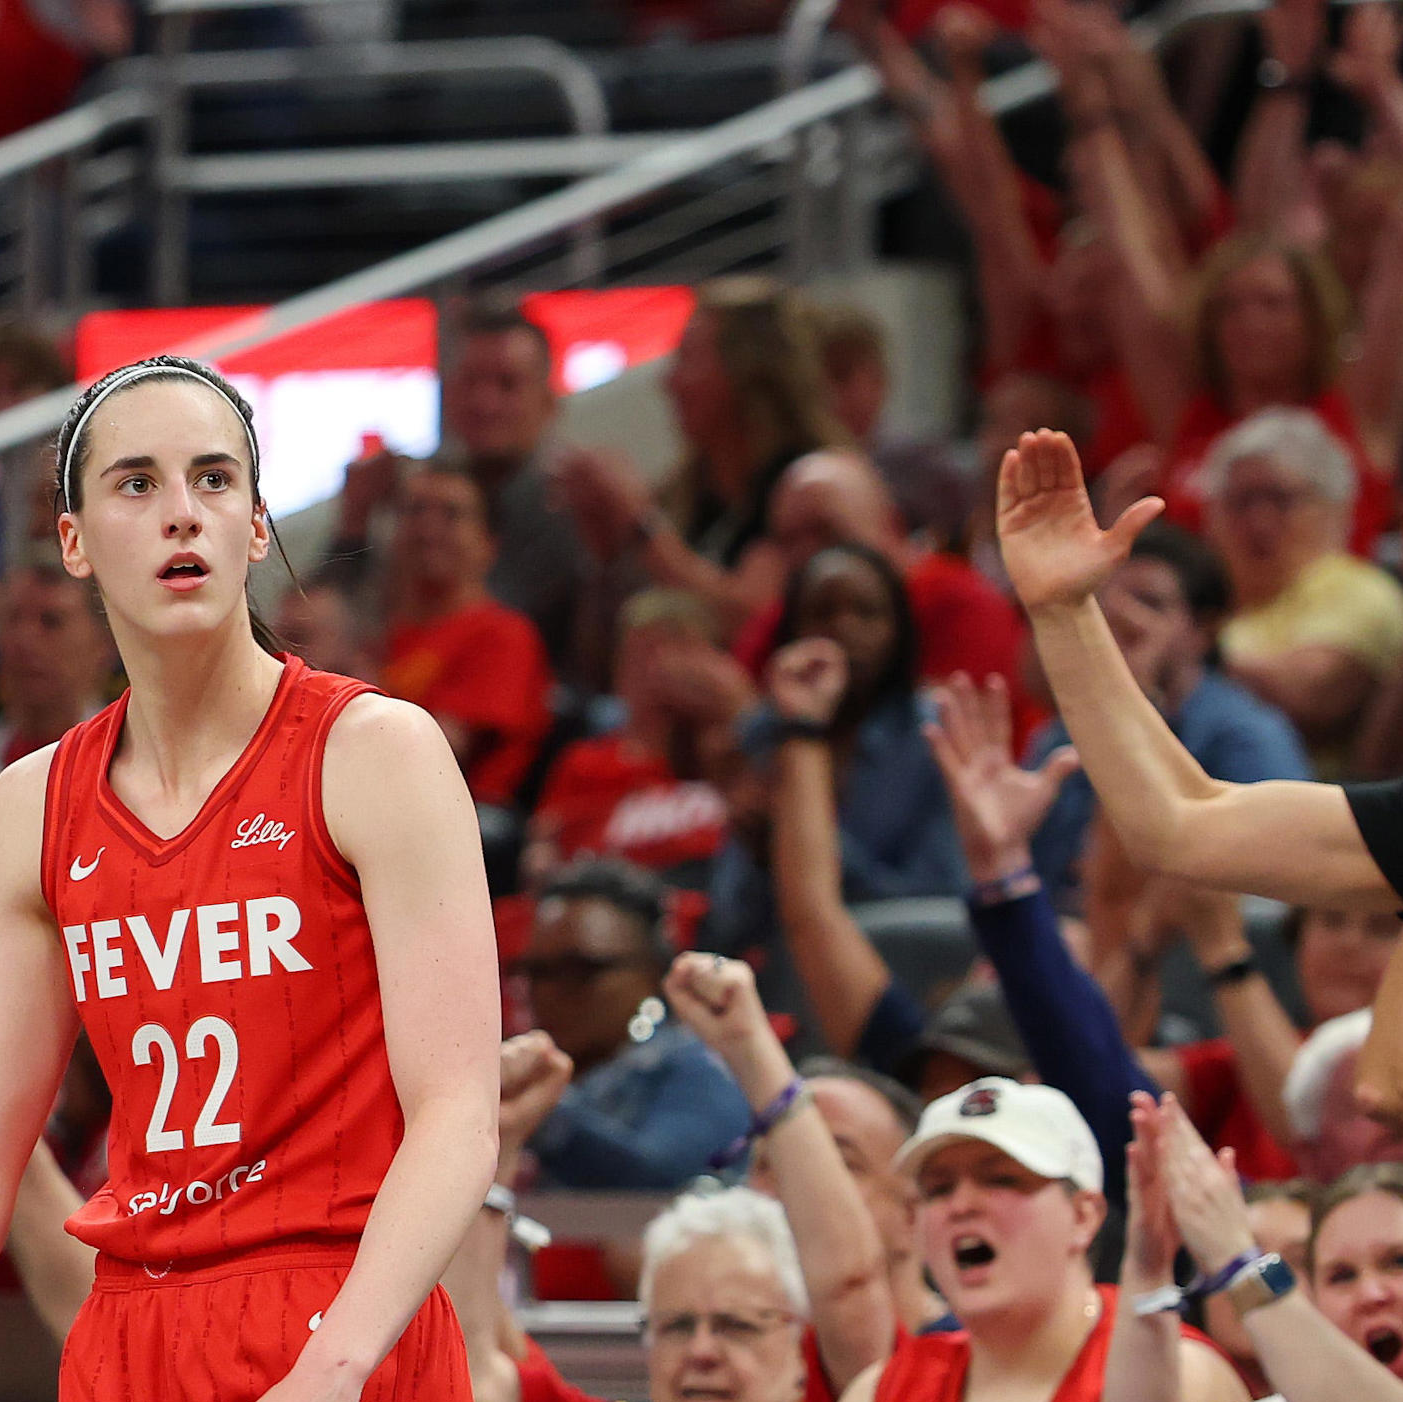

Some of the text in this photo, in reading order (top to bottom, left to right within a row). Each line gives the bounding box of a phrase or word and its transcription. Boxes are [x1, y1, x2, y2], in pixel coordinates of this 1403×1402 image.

[231, 812, 296, 851] Lilly
[62, 895, 314, 1003] FEVER
[131, 1015, 241, 1153] 22
